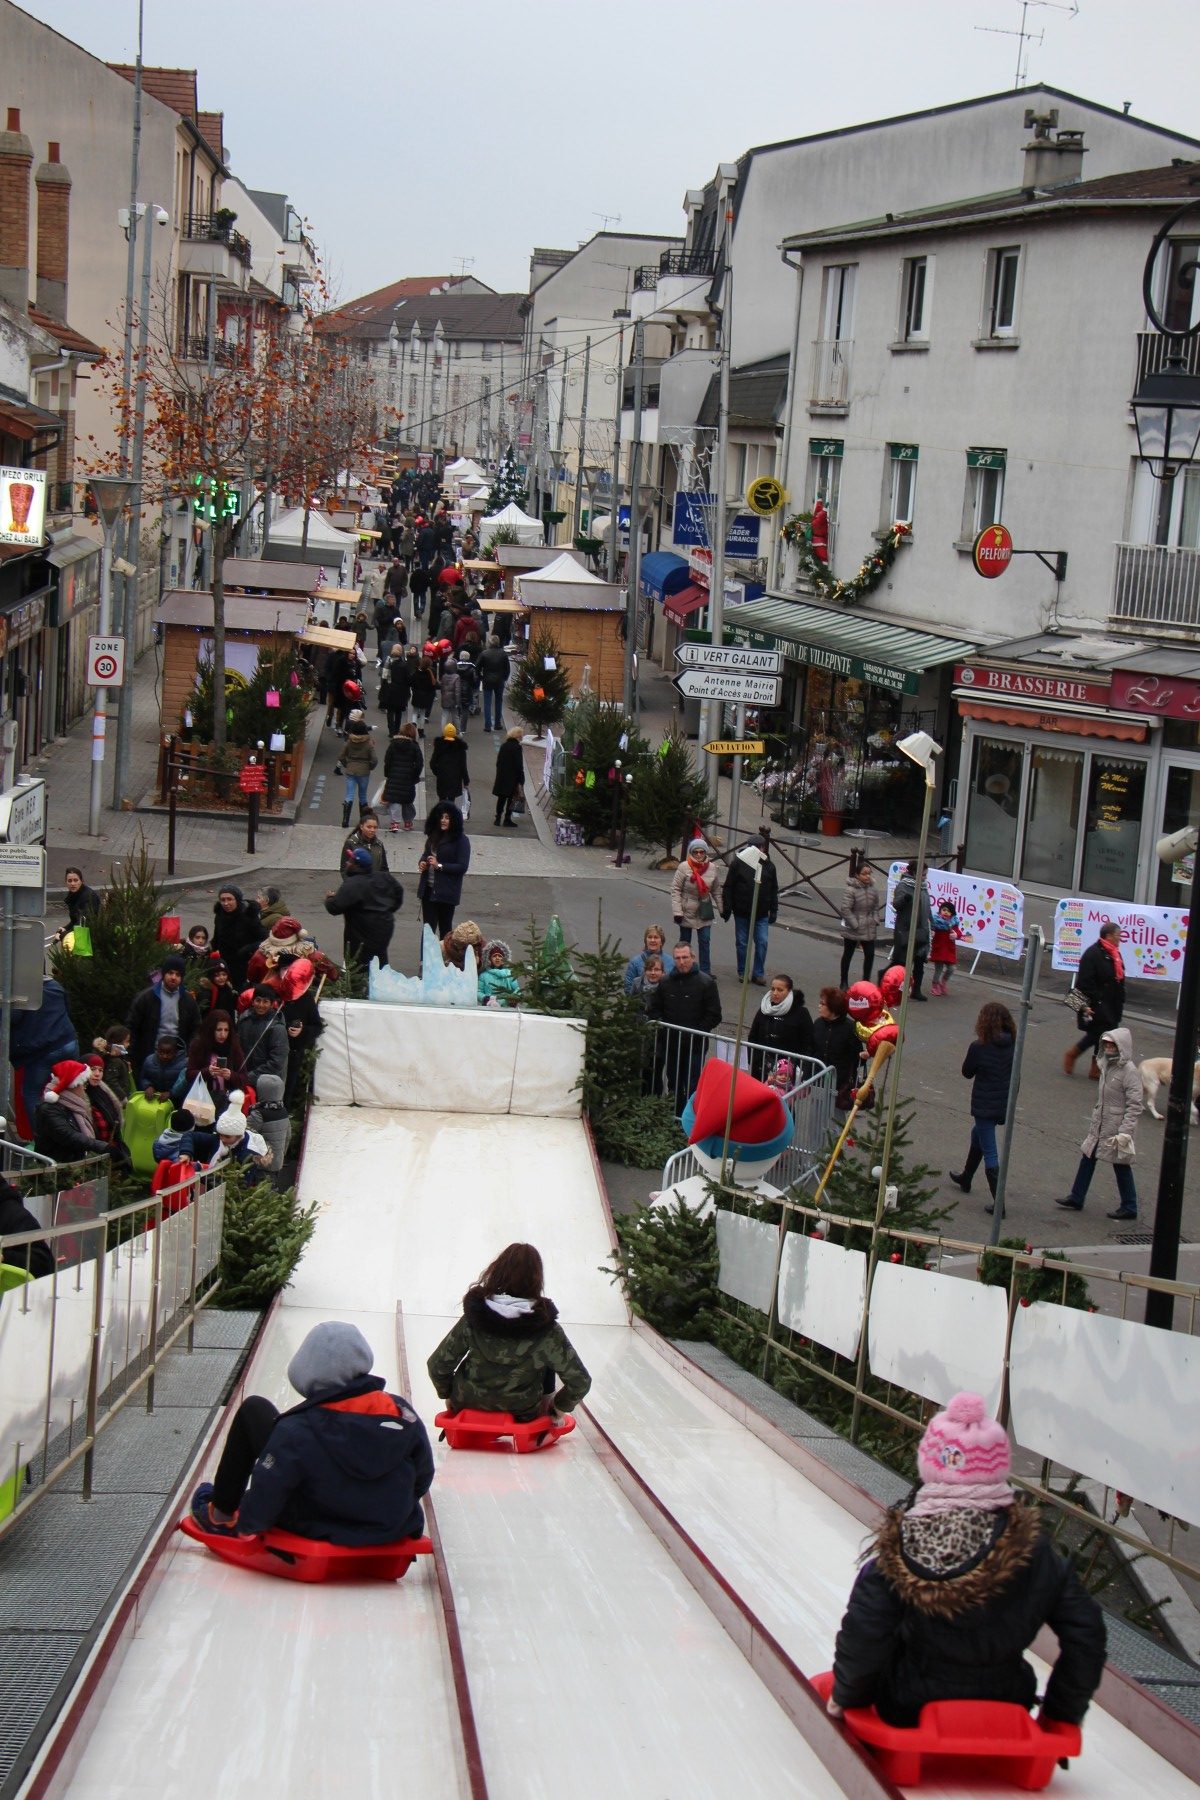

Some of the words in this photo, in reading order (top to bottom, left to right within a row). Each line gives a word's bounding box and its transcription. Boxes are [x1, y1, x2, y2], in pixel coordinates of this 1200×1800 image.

[2, 470, 22, 480] MEZO
[24, 472, 44, 482] GRILL
[728, 528, 750, 536] EADER
[95, 643, 119, 651] ZONE
[703, 650, 729, 662] VERT
[731, 653, 774, 667] GALANT
[798, 644, 809, 661] DE
[810, 647, 852, 675] VILLEPINTE
[100, 662, 111, 671] 30
[704, 675, 742, 687] Antenne
[745, 679, 774, 690] Mairie
[988, 672, 1087, 700] BRASSERIE
[688, 684, 709, 695] Point
[710, 687, 741, 698] d'Accès
[753, 691, 773, 701] Droit
[1124, 676, 1174, 707] Le
[1040, 715, 1058, 726] BAR
[709, 742, 756, 751] DEVIATION
[936, 882, 959, 896] ville
[1088, 910, 1110, 923] Ma
[1118, 914, 1146, 927] ville
[1120, 925, 1169, 947] étille
